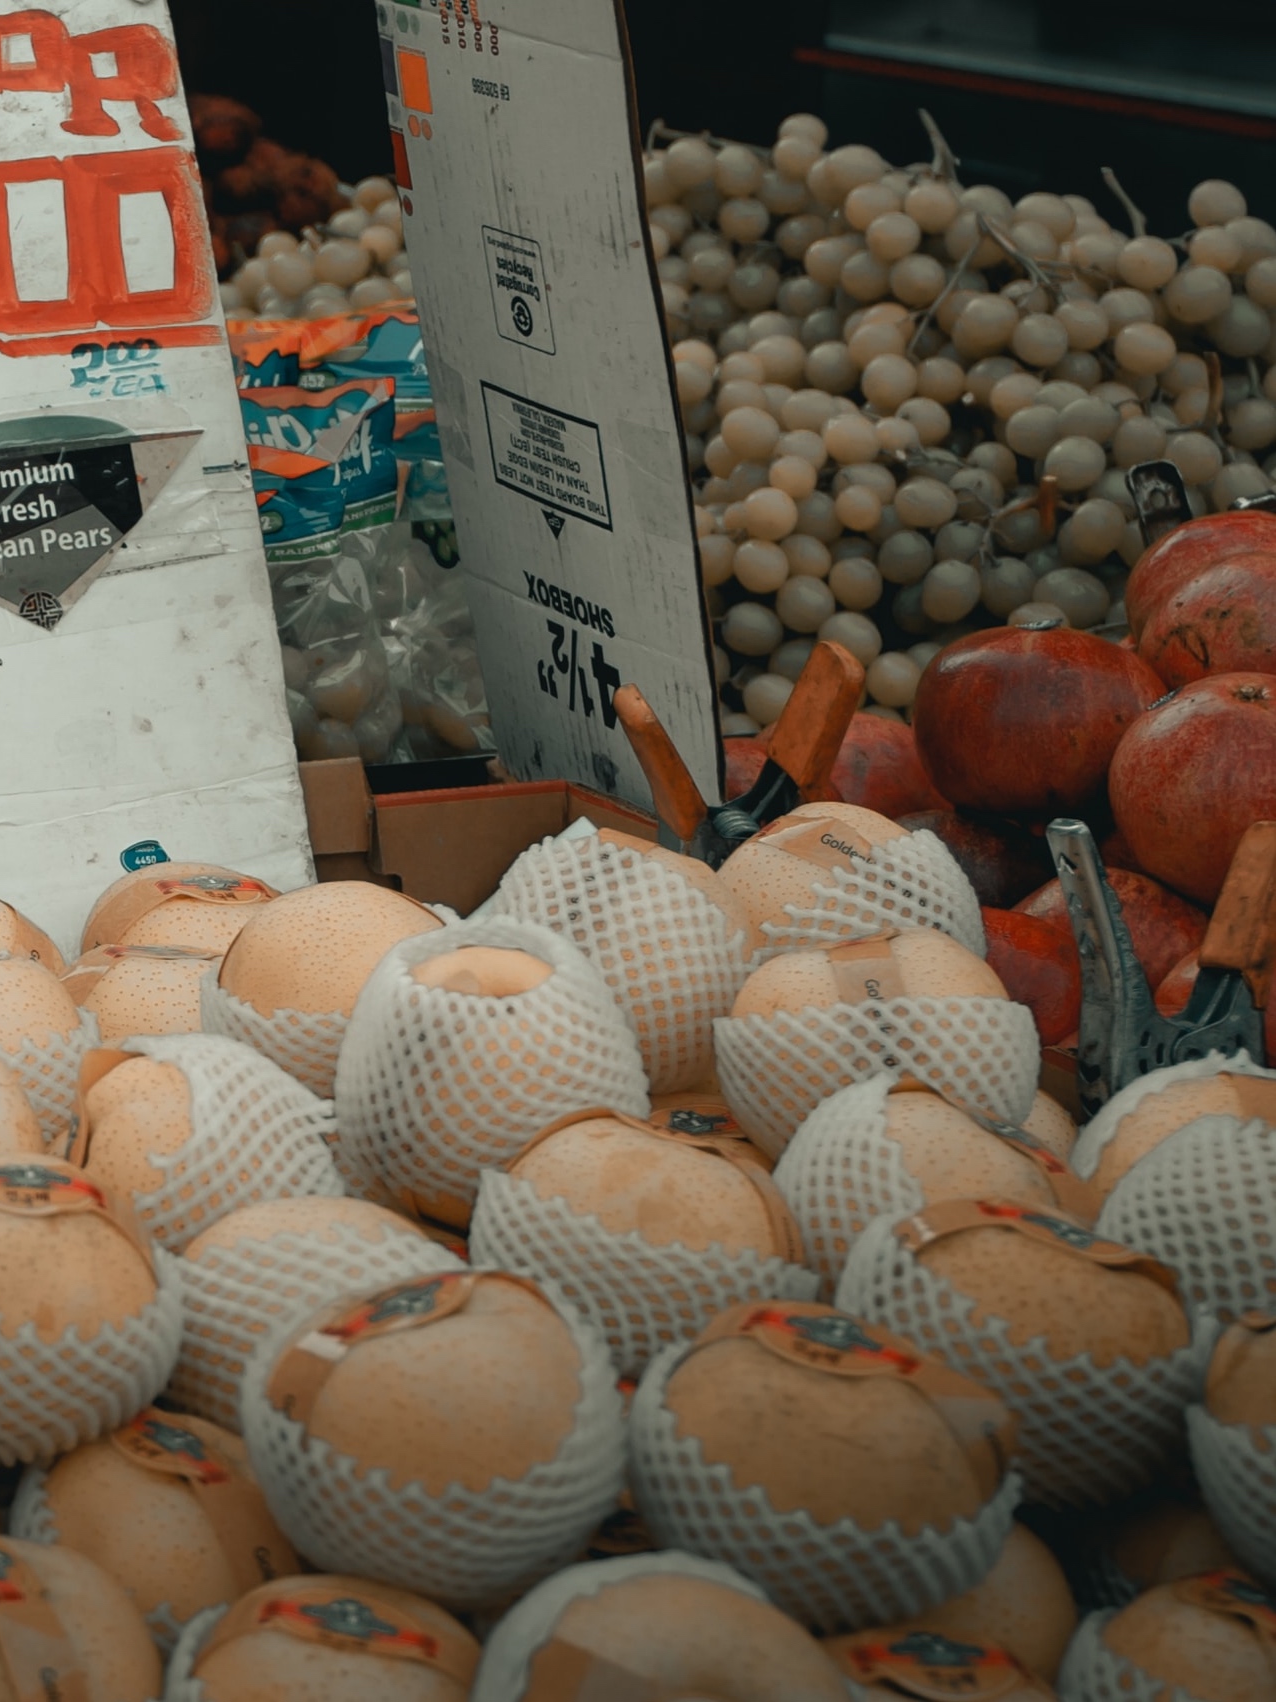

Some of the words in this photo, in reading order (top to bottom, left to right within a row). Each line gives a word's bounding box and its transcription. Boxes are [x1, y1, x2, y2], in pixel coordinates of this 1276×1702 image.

[496, 256, 534, 282] Recycles
[495, 273, 541, 302] Corrugated
[506, 449, 528, 469] EDGE
[531, 444, 551, 462] TEST
[551, 451, 580, 474] CRUSH
[497, 461, 518, 480] LESS
[535, 478, 554, 497] TEST
[565, 473, 589, 494] THAN
[555, 486, 585, 510] BOARD
[586, 498, 606, 518] THIS
[41, 523, 112, 556] Pears
[523, 569, 616, 638] SHOEBOX
[134, 855, 157, 865] 4450
